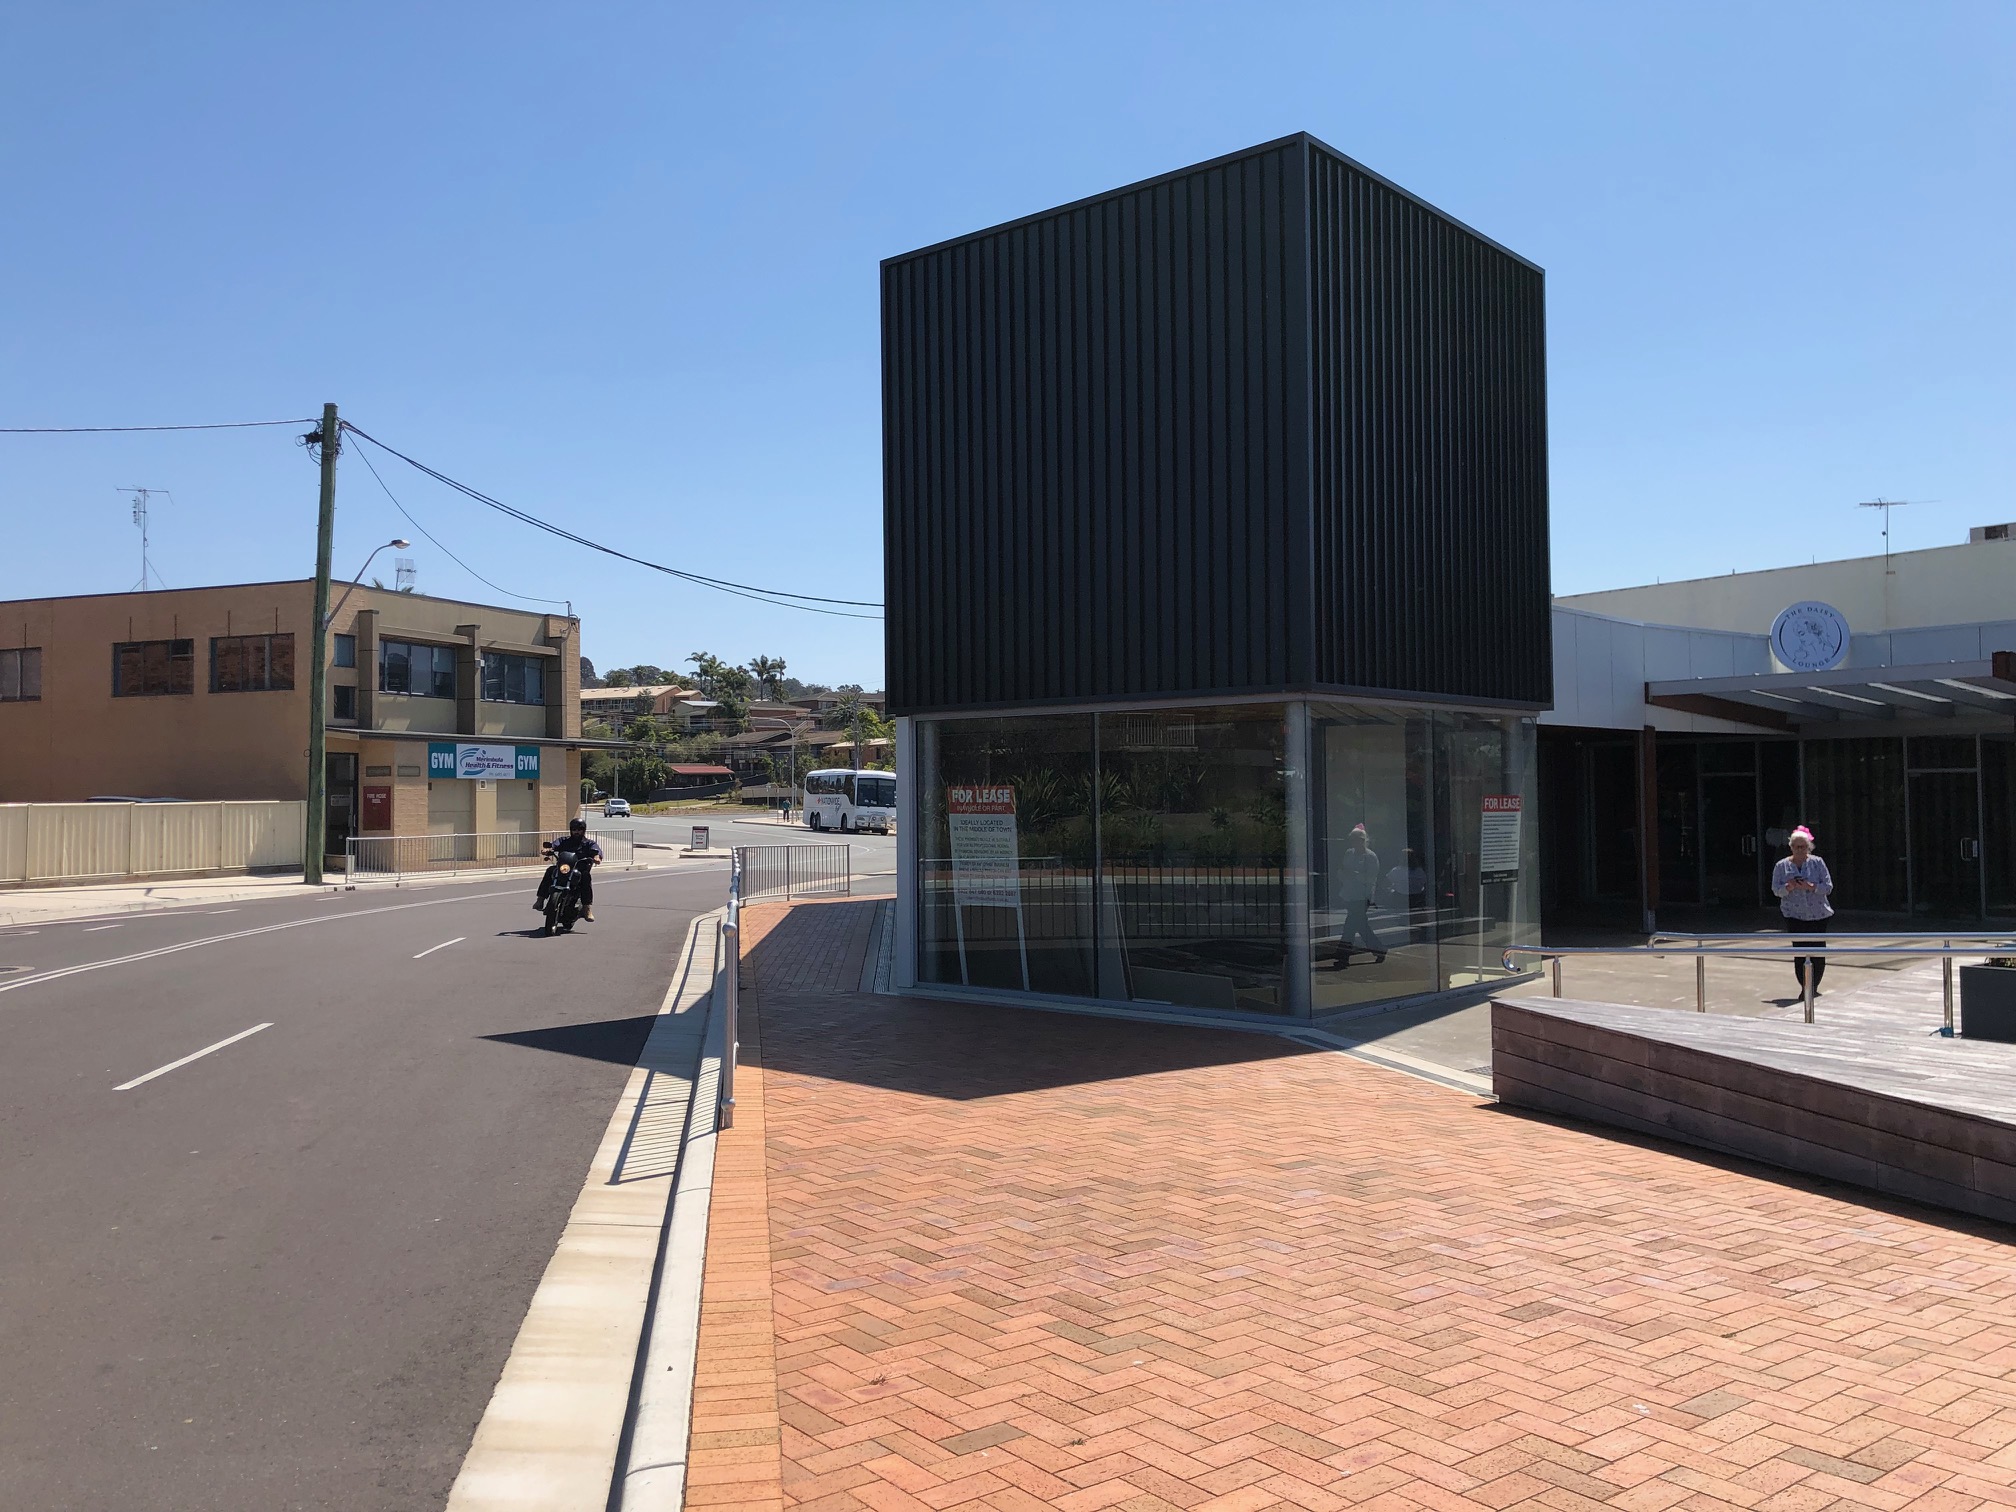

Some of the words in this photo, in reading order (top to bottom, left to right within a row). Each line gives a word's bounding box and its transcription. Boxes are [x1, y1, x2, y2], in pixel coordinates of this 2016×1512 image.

[1785, 608, 1803, 620] THE
[1807, 606, 1835, 618] DAISY
[1792, 657, 1831, 668] LOUNGE
[431, 752, 454, 769] GYM
[517, 754, 538, 771] GYM
[952, 789, 973, 803] FOR
[976, 789, 1010, 803] LEASE
[1484, 797, 1498, 810] FOR
[1499, 797, 1520, 809] LEASE
